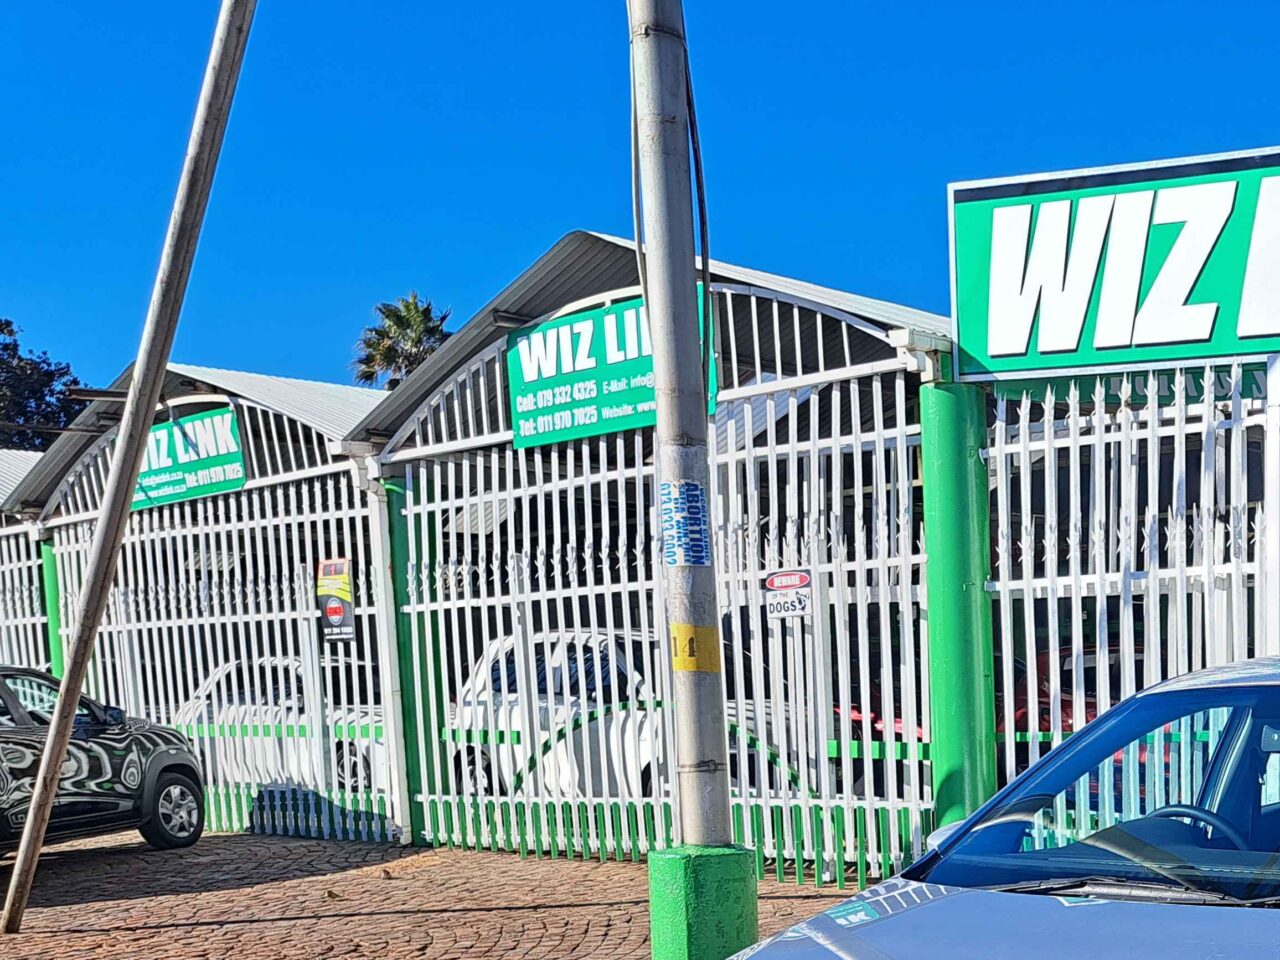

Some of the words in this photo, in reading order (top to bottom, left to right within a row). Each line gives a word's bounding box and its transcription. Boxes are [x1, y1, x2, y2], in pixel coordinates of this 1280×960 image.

[987, 180, 1238, 357] WIZ
[517, 319, 596, 383] WIZ
[604, 305, 654, 365] LI
[173, 413, 239, 465] LINK
[518, 417, 537, 437] Tel:
[685, 482, 705, 565] ABORTION
[768, 600, 797, 614] DOGS
